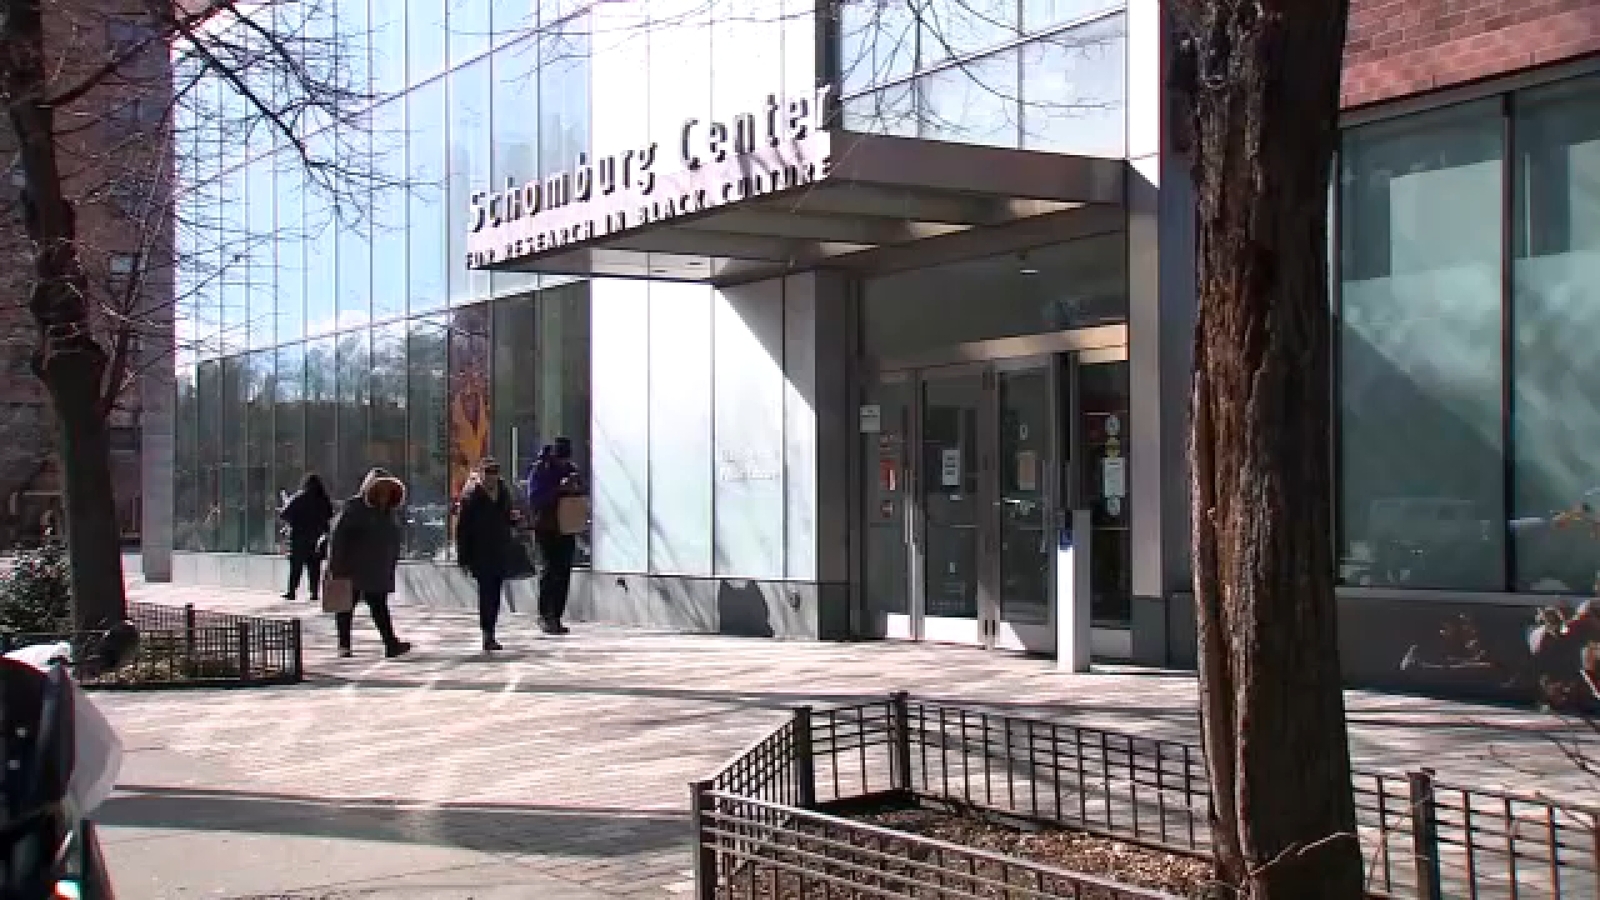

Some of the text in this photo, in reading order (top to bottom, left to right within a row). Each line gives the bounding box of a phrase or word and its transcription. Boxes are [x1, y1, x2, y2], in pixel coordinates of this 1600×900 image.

[470, 84, 831, 233] Schomburg Center
[505, 219, 596, 258] RESEARCH
[604, 209, 627, 235] IN
[638, 189, 707, 225] BLACK
[721, 156, 831, 201] CULTURE
